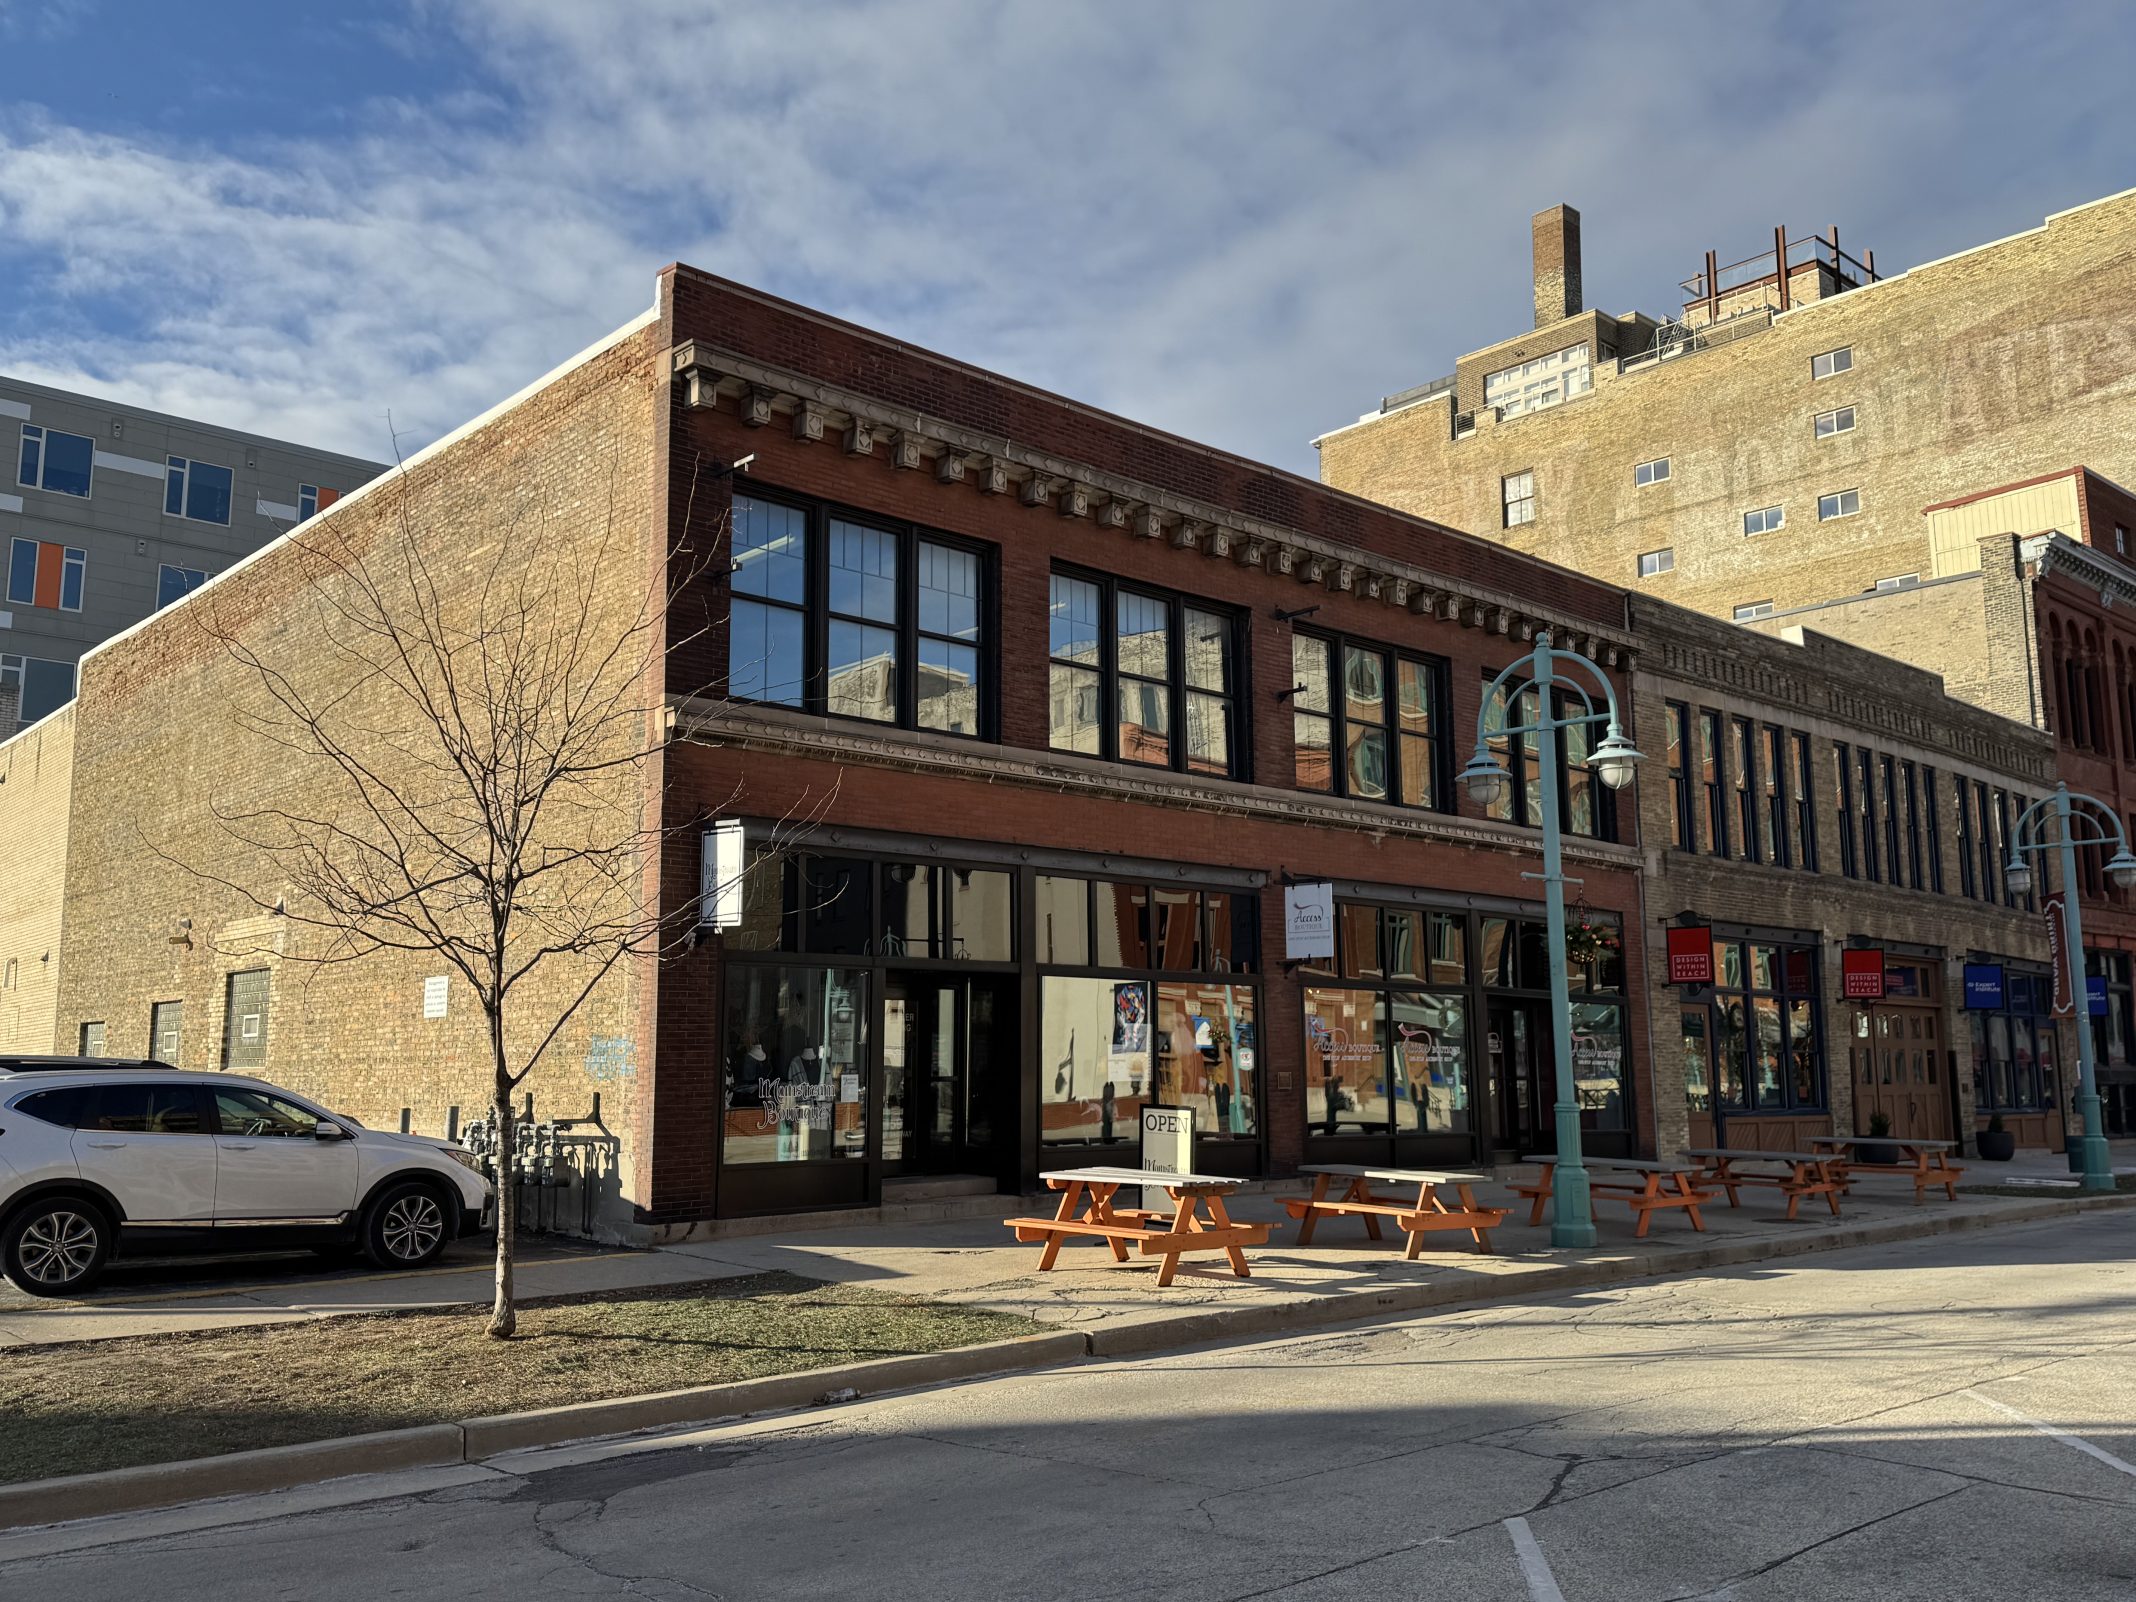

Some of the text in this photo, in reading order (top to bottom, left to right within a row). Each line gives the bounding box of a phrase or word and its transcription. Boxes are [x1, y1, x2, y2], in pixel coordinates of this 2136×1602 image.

[1293, 910, 1322, 923] Access
[1675, 956, 1705, 964] DESIGN
[2052, 956, 2060, 996] WARD
[758, 1077, 836, 1105] Mainstream
[756, 1100, 829, 1130] Boutique
[1145, 1114, 1189, 1134] OPEN
